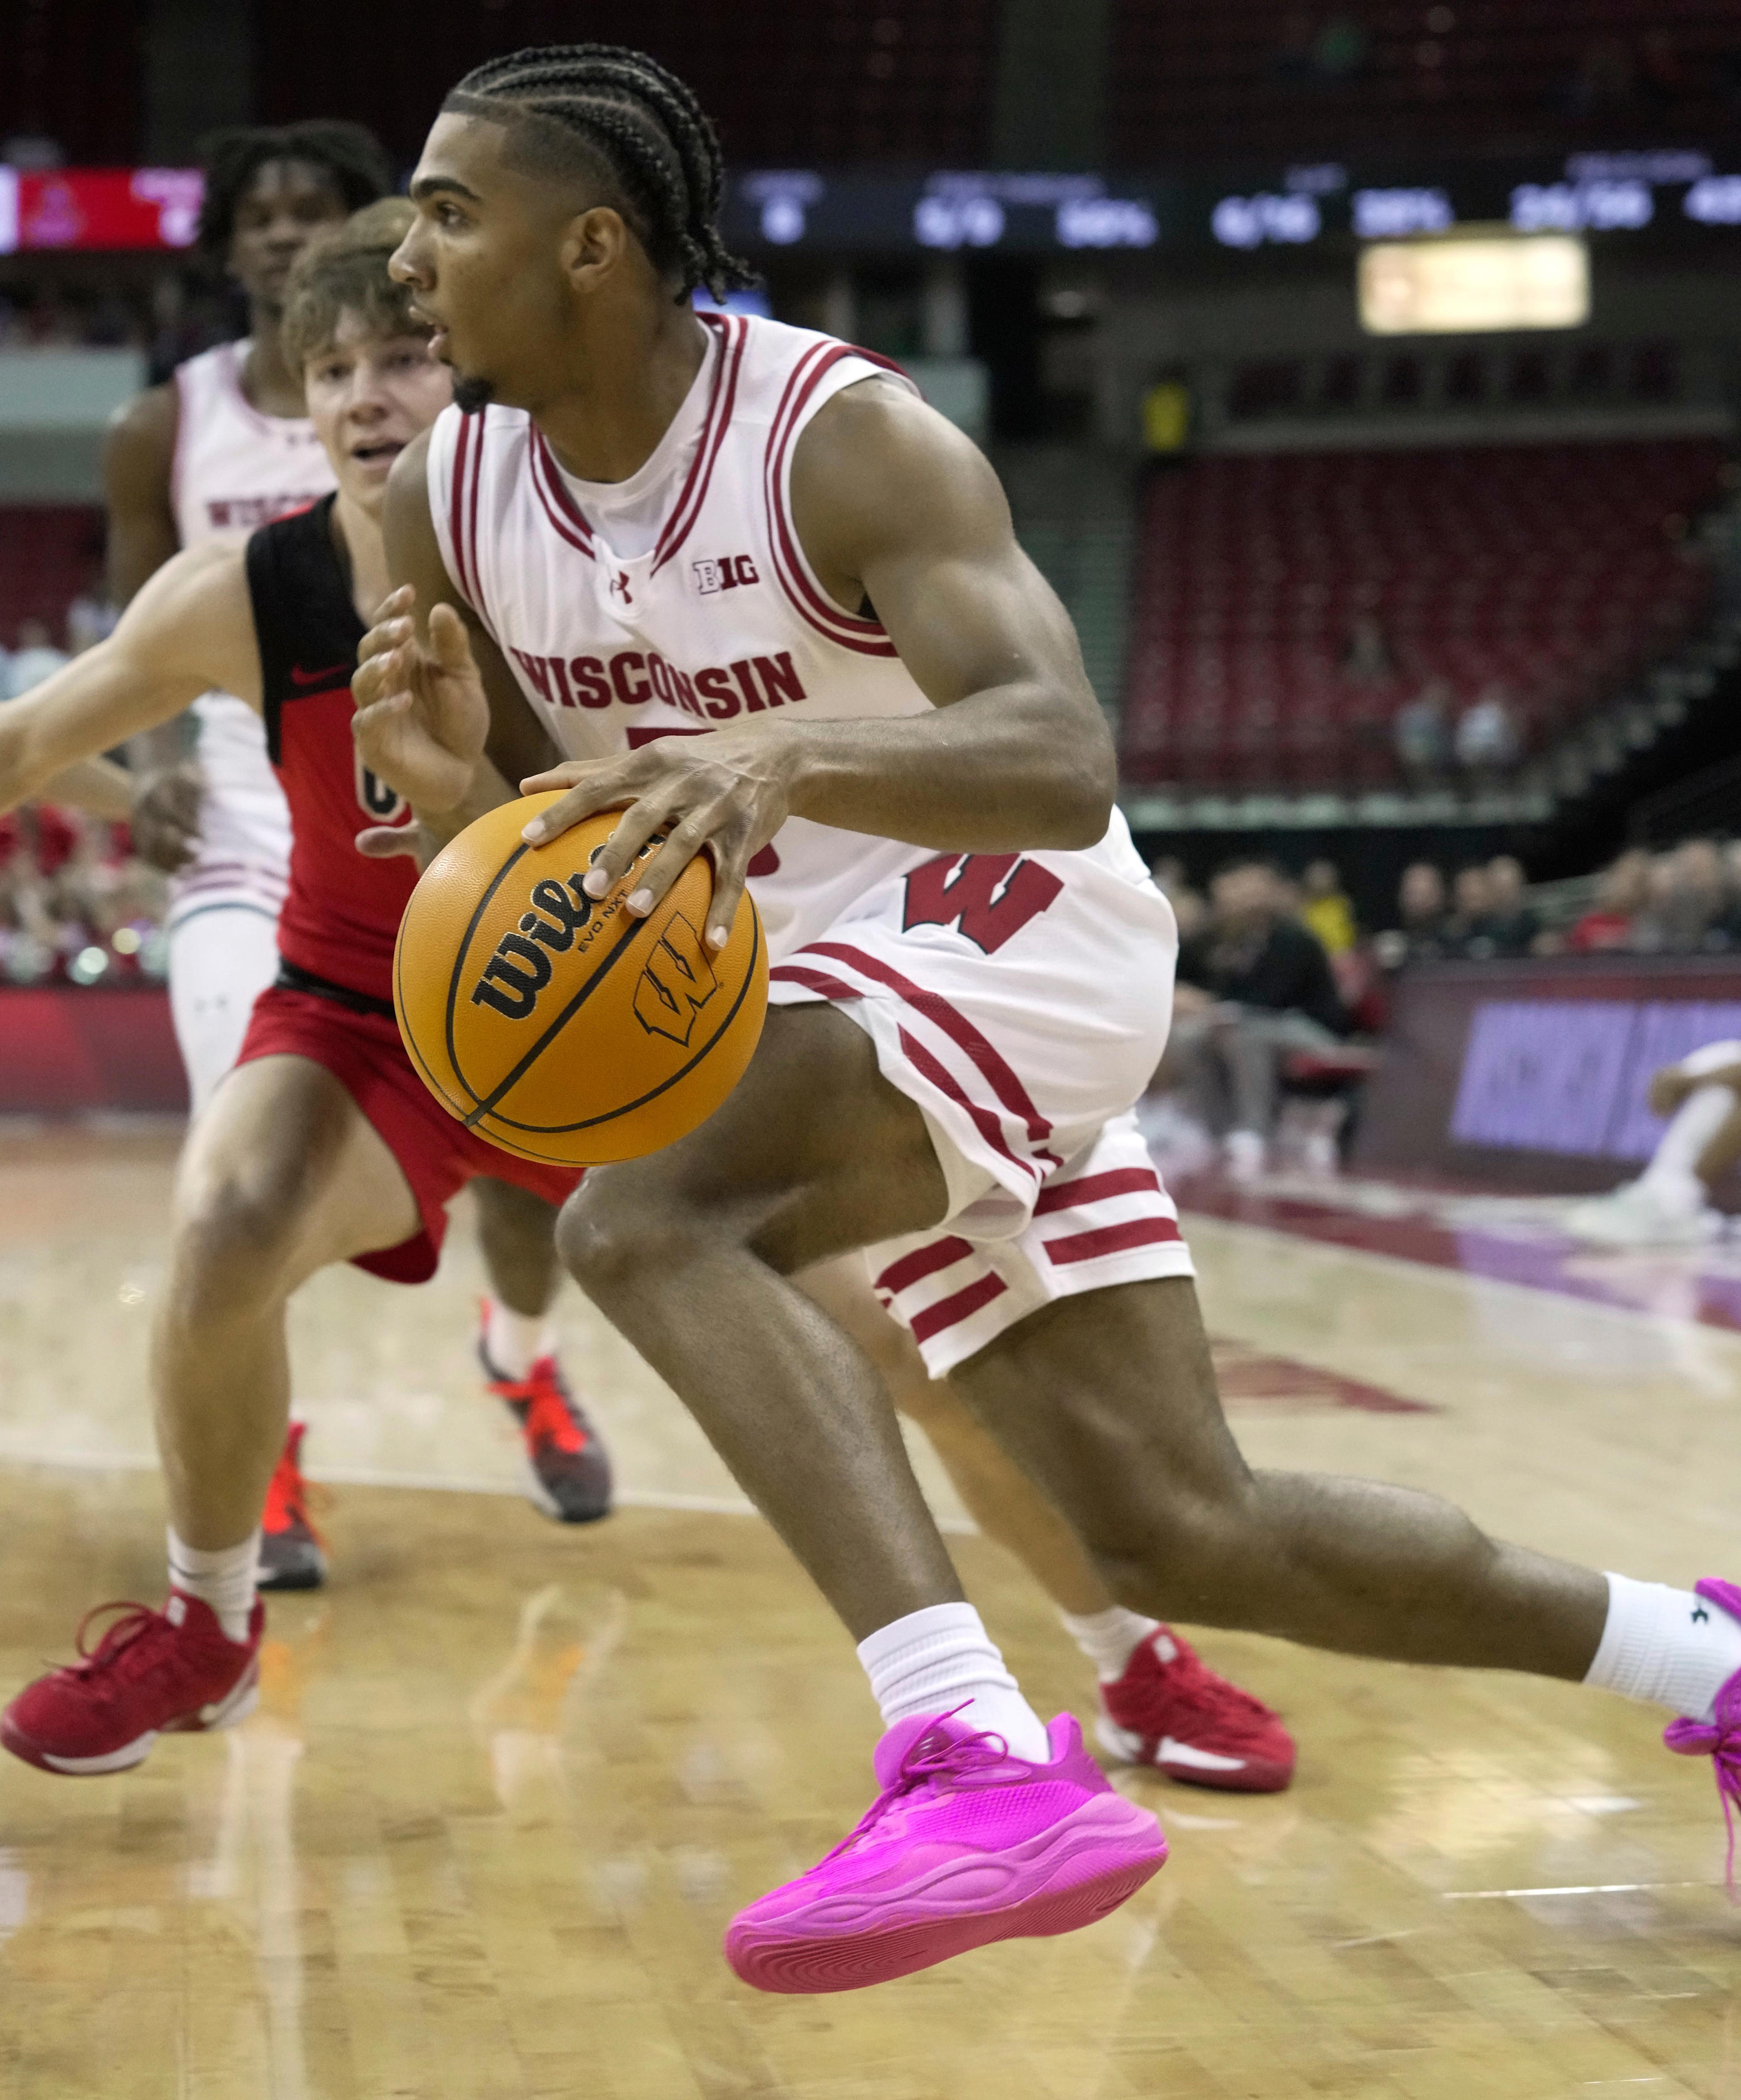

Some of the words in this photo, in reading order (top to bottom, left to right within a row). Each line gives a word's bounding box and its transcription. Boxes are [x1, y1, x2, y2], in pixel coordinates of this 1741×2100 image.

[508, 646, 807, 720] WISCONSIN
[577, 920, 604, 954] EVO
[602, 889, 629, 919] NXT
[900, 852, 1065, 956] W
